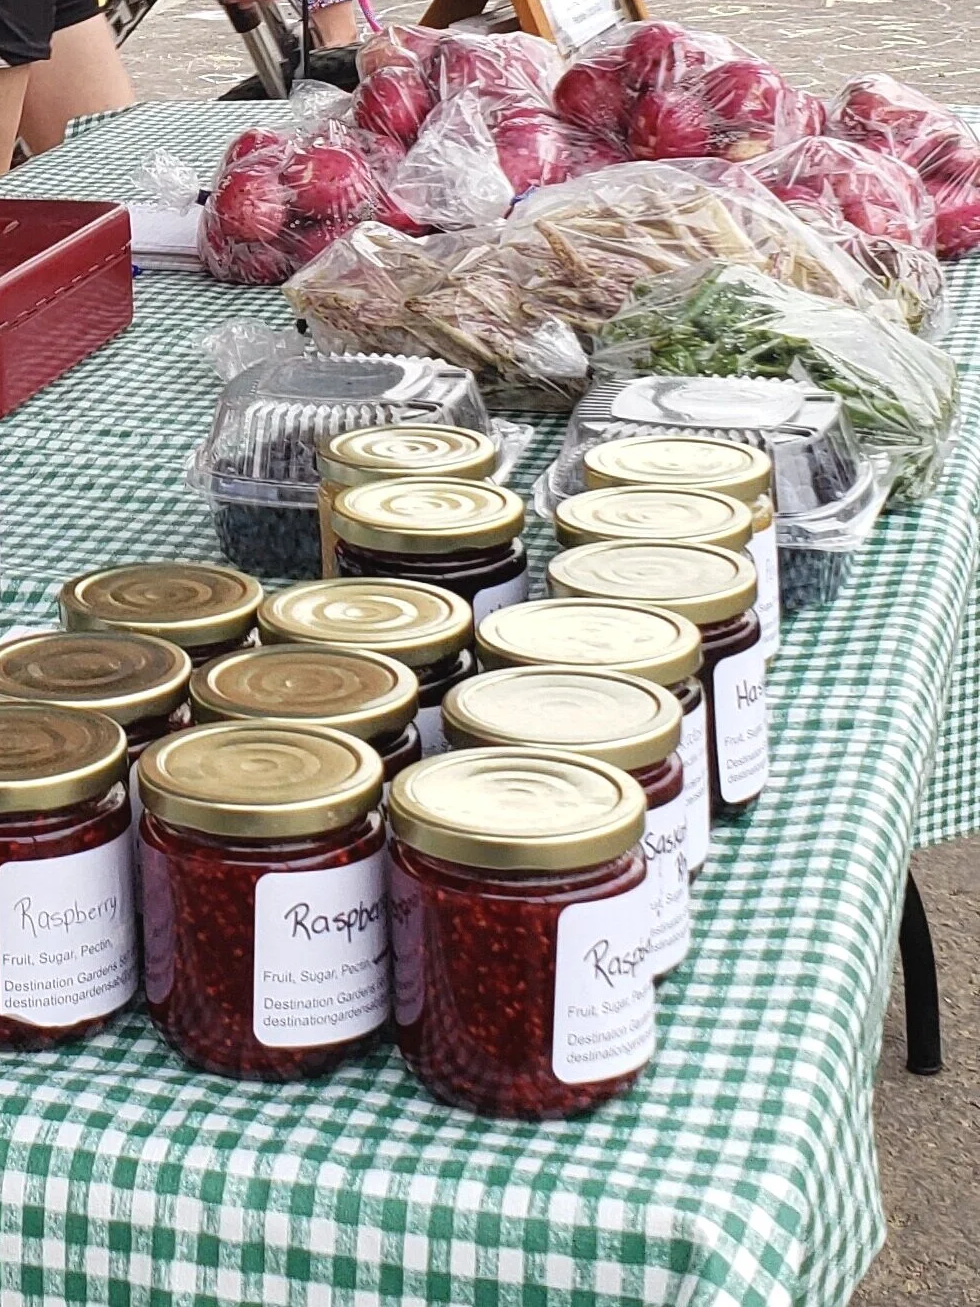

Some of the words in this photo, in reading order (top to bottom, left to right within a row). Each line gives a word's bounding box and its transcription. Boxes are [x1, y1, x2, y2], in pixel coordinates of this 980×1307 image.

[13, 895, 117, 938] Raspberry
[2, 953, 35, 966] Fruit,
[39, 949, 77, 966] Sugar,
[4, 976, 74, 992] Destination
[77, 962, 117, 984] Gardens
[263, 970, 297, 984] Fruit,
[300, 968, 338, 984] Sugar,
[264, 996, 334, 1010] Destination
[567, 1003, 598, 1019] Fruit,
